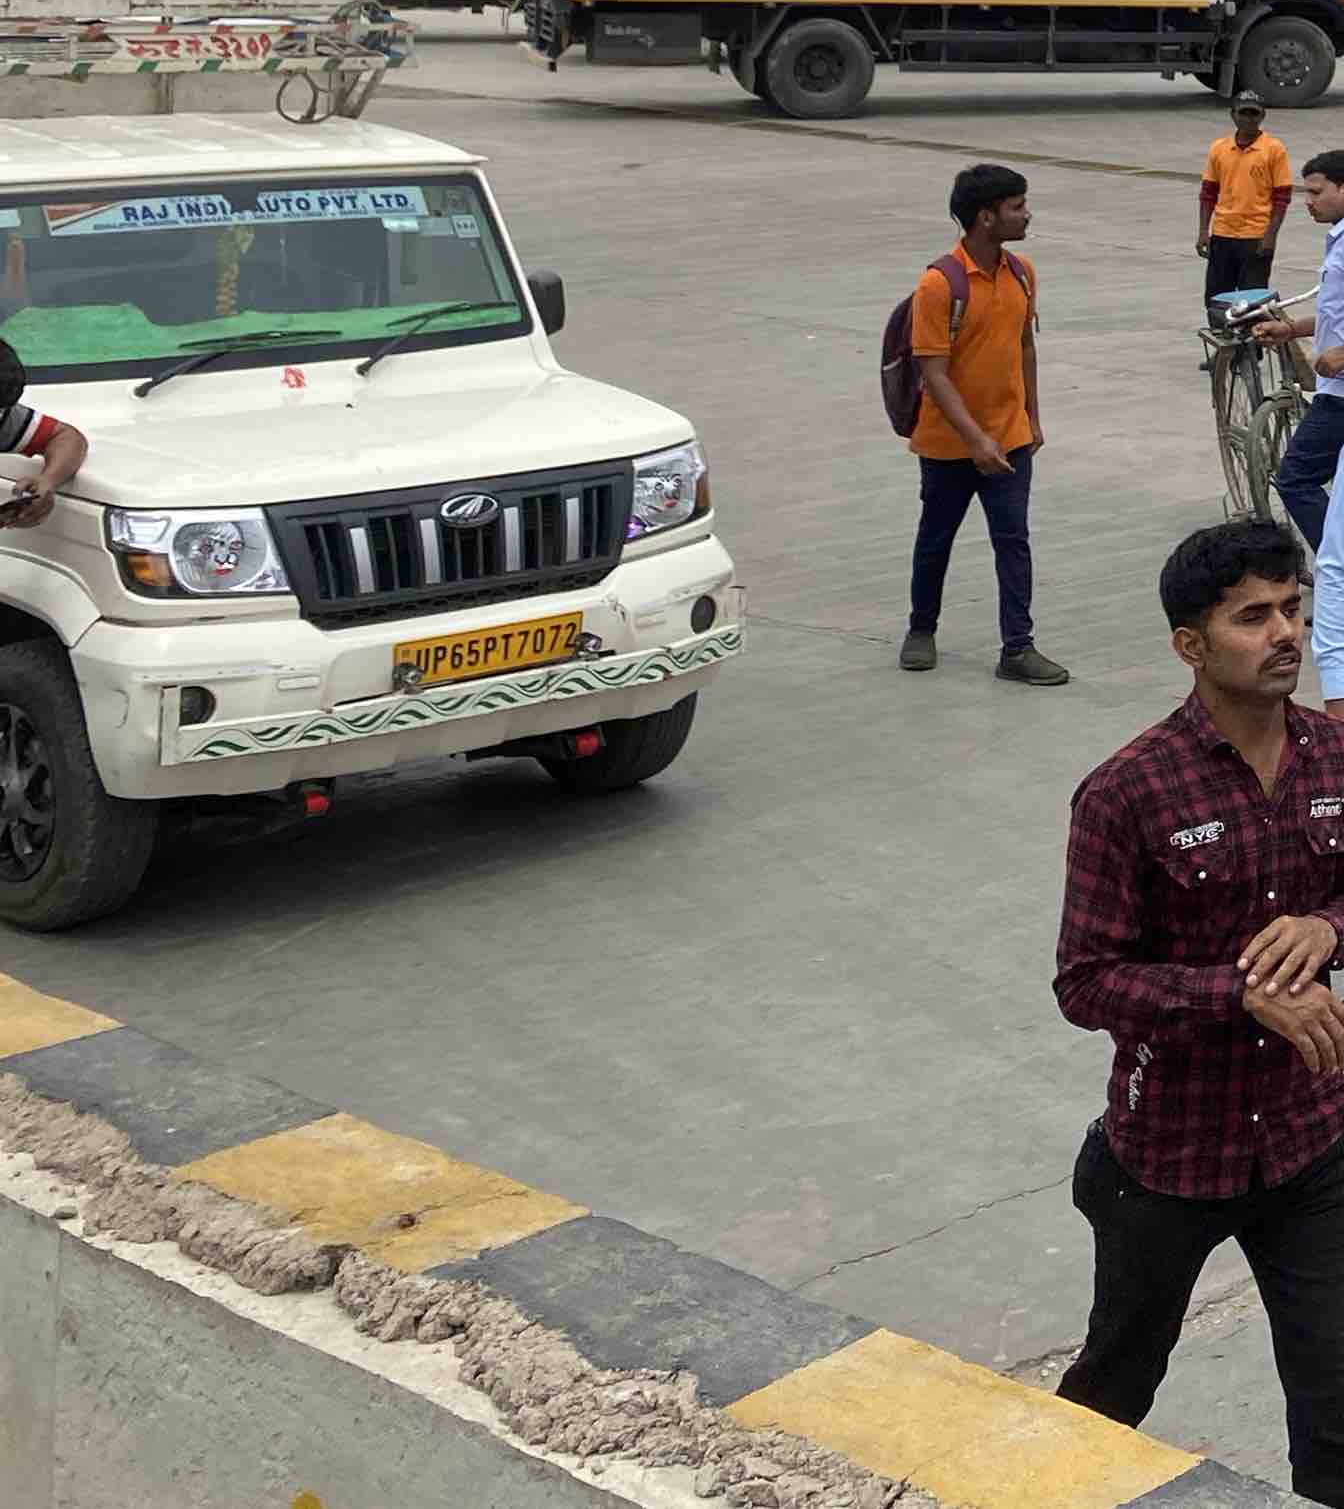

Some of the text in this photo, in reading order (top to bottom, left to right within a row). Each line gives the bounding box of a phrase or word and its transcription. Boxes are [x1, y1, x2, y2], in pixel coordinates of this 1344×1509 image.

[122, 204, 169, 222] RAJ
[176, 201, 229, 219] INDI
[416, 621, 577, 675] UP65PT7072
[1180, 826, 1220, 847] NYC
